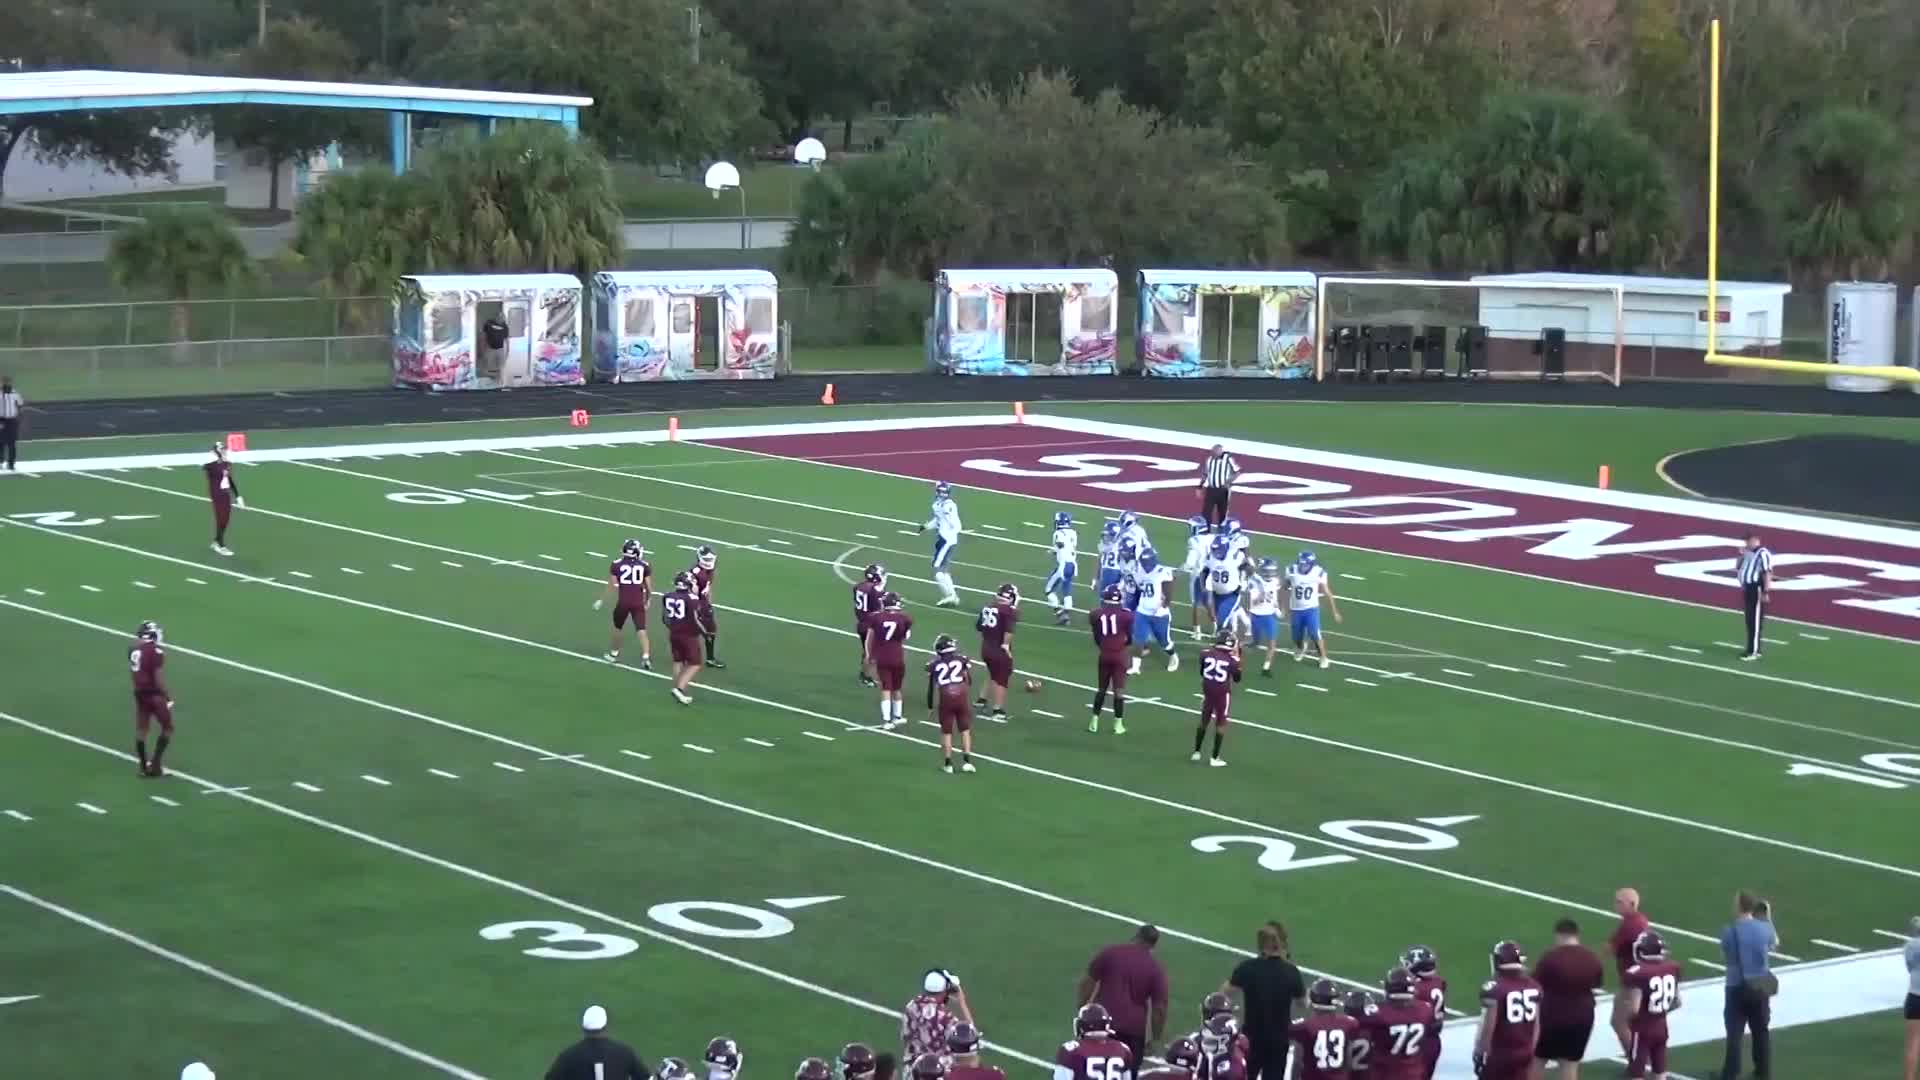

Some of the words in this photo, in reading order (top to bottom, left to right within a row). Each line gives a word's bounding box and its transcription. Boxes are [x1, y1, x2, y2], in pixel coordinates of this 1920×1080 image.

[619, 563, 645, 585] 20
[665, 597, 686, 620] 53
[855, 590, 869, 612] 51
[882, 621, 898, 641] 7
[1099, 613, 1118, 637] 11
[130, 649, 142, 672] 9
[934, 659, 965, 686] 22
[1203, 656, 1231, 683] 25
[1190, 819, 1459, 871] 20
[479, 900, 795, 960] 30
[1506, 988, 1540, 1024] 65
[1648, 974, 1676, 1013] 28
[1313, 1029, 1345, 1069] 43
[1389, 1023, 1425, 1056] 72
[1086, 1056, 1126, 1080] 56
